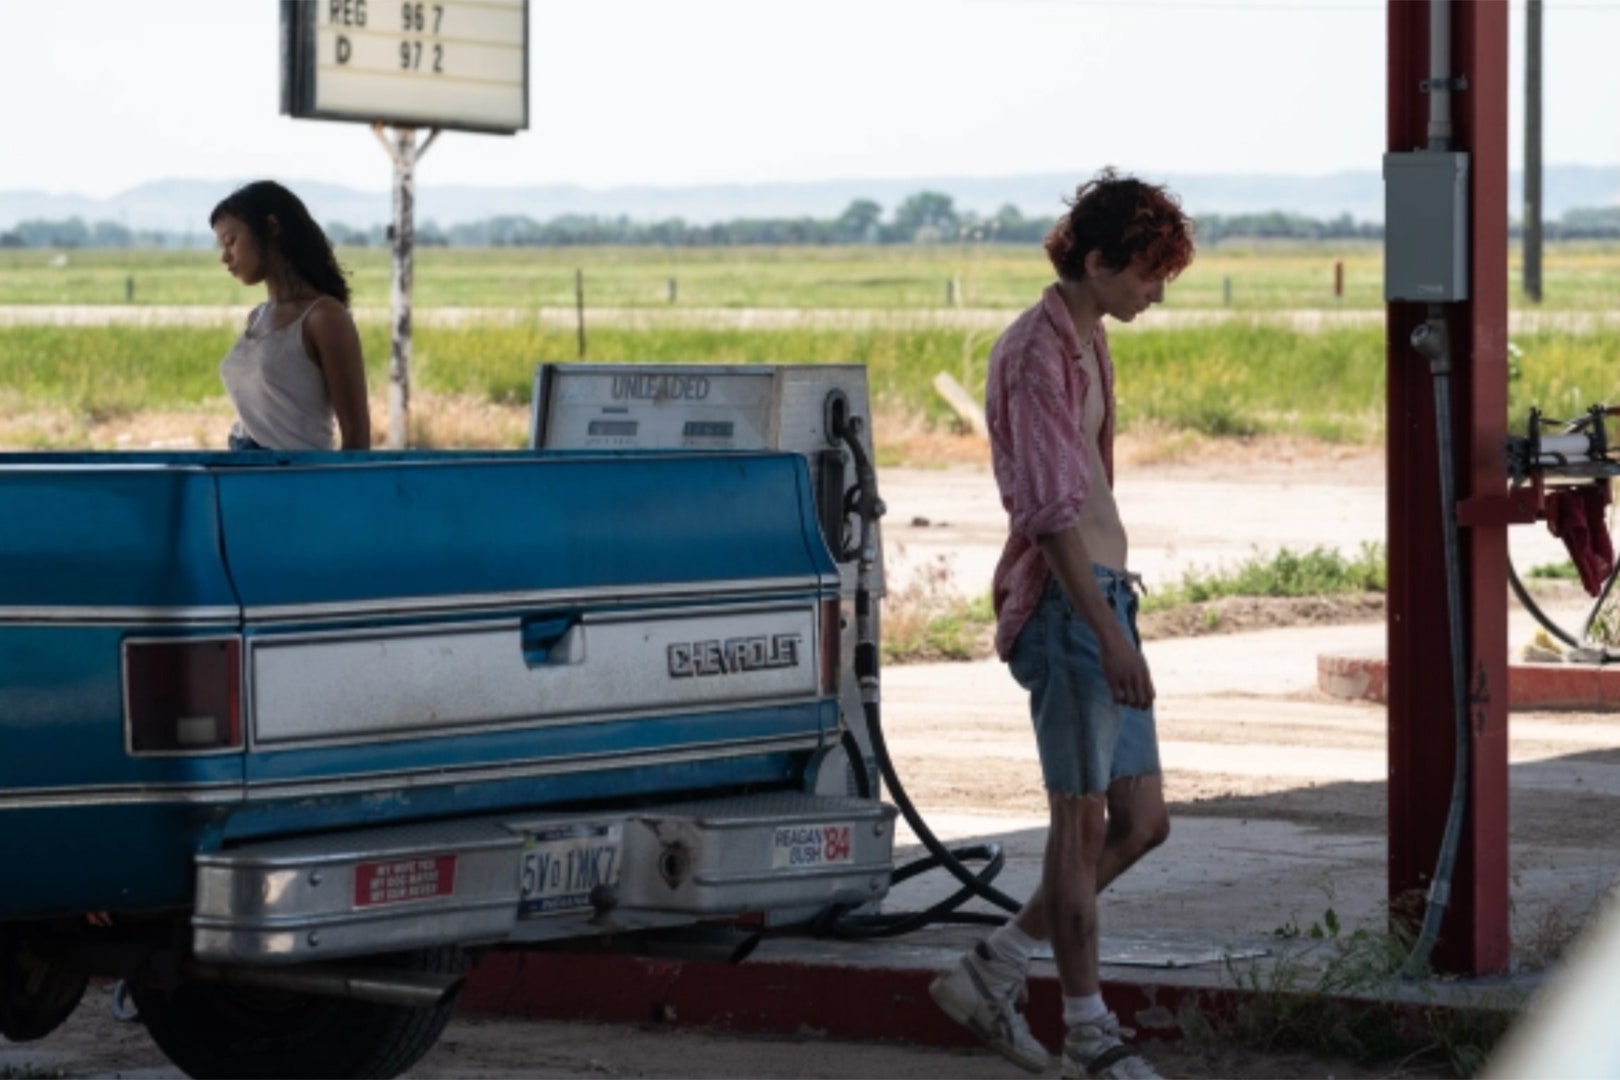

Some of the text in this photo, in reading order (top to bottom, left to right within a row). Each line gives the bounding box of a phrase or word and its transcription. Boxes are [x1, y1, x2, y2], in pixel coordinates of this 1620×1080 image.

[330, 0, 367, 27] REG
[335, 35, 352, 65] D
[611, 375, 712, 401] UNLEADED
[667, 633, 802, 678] CHEVROLET
[775, 828, 821, 848] REAGAN
[790, 846, 821, 865] BUSH
